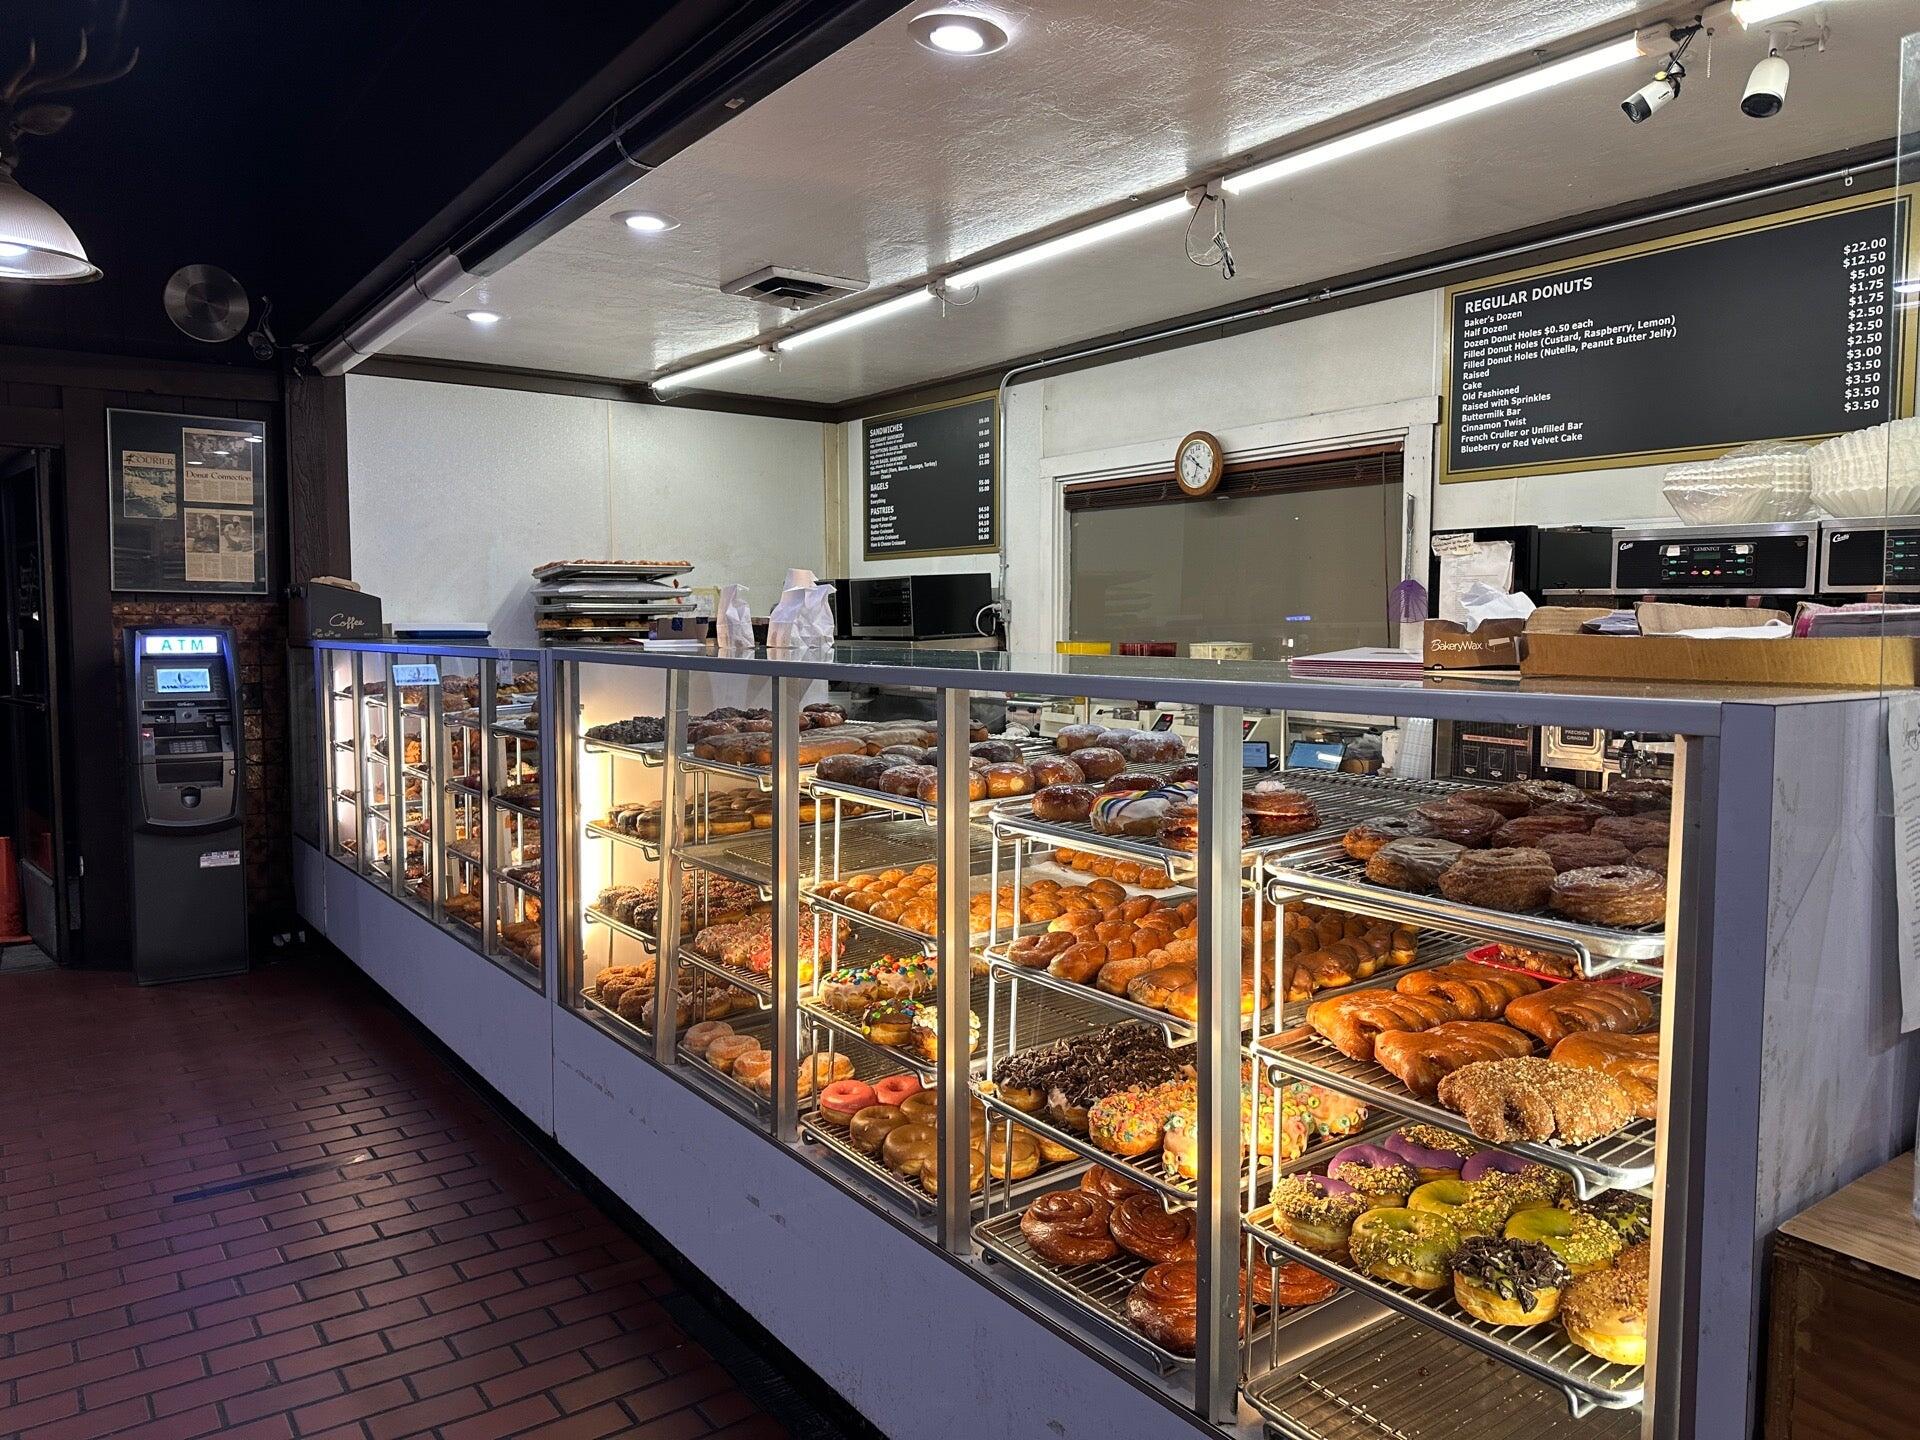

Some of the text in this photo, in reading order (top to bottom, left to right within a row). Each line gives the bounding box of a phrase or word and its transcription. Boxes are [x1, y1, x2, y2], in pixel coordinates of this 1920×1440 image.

[1843, 238, 1886, 256] $22.00
[1843, 251, 1886, 269] $12.50
[1850, 265, 1885, 281] $5.00
[1849, 279, 1884, 294] $1.75
[1465, 276, 1593, 314] REGULAR DONUTS
[1849, 292, 1884, 307] $1.75
[1464, 310, 1522, 327] Baker's Dozen
[1848, 305, 1884, 320] $2.50
[1464, 324, 1508, 338] Half Dozen
[1464, 319, 1593, 348] Dozen Donut Holes $0.50 each
[1848, 319, 1882, 333] $2.50
[1464, 315, 1675, 359] Filled Donut Holes (Custard, Raspberry, Lemon)
[1847, 332, 1882, 347] $2.50
[1463, 326, 1677, 370] Filled Donut Holes (Nutella, Peanut Butter Jelly)
[1846, 346, 1882, 360] $3.00
[1846, 359, 1881, 373] $3.50
[1463, 369, 1490, 380] Raised
[1845, 372, 1880, 386] $3.50
[1462, 382, 1482, 391] Cake
[1462, 386, 1520, 401] Old Fashioned
[1845, 386, 1880, 399] $3.50
[1462, 393, 1551, 411] Raised with Sprinkles
[1844, 399, 1879, 413] $3.50
[1462, 408, 1521, 422] Buttermilk Bar
[870, 423, 903, 437] SANDWICHES
[1461, 417, 1526, 432] Cinnamon Twist
[1461, 432, 1488, 443] French
[1490, 430, 1518, 440] Cruller
[1532, 423, 1565, 434] Unfilled
[1568, 422, 1583, 431] Bar
[1461, 443, 1500, 454] Blueberry
[1513, 439, 1529, 448] Red
[1531, 436, 1559, 445] Velvet
[1561, 433, 1583, 442] Cake
[186, 470, 251, 480] Donut Connection
[870, 482, 889, 491] BAGELS
[870, 506, 894, 515] PASTRIES
[329, 613, 365, 630] Coffee
[161, 639, 204, 651] ATM
[1431, 639, 1483, 652] BakeryWax
